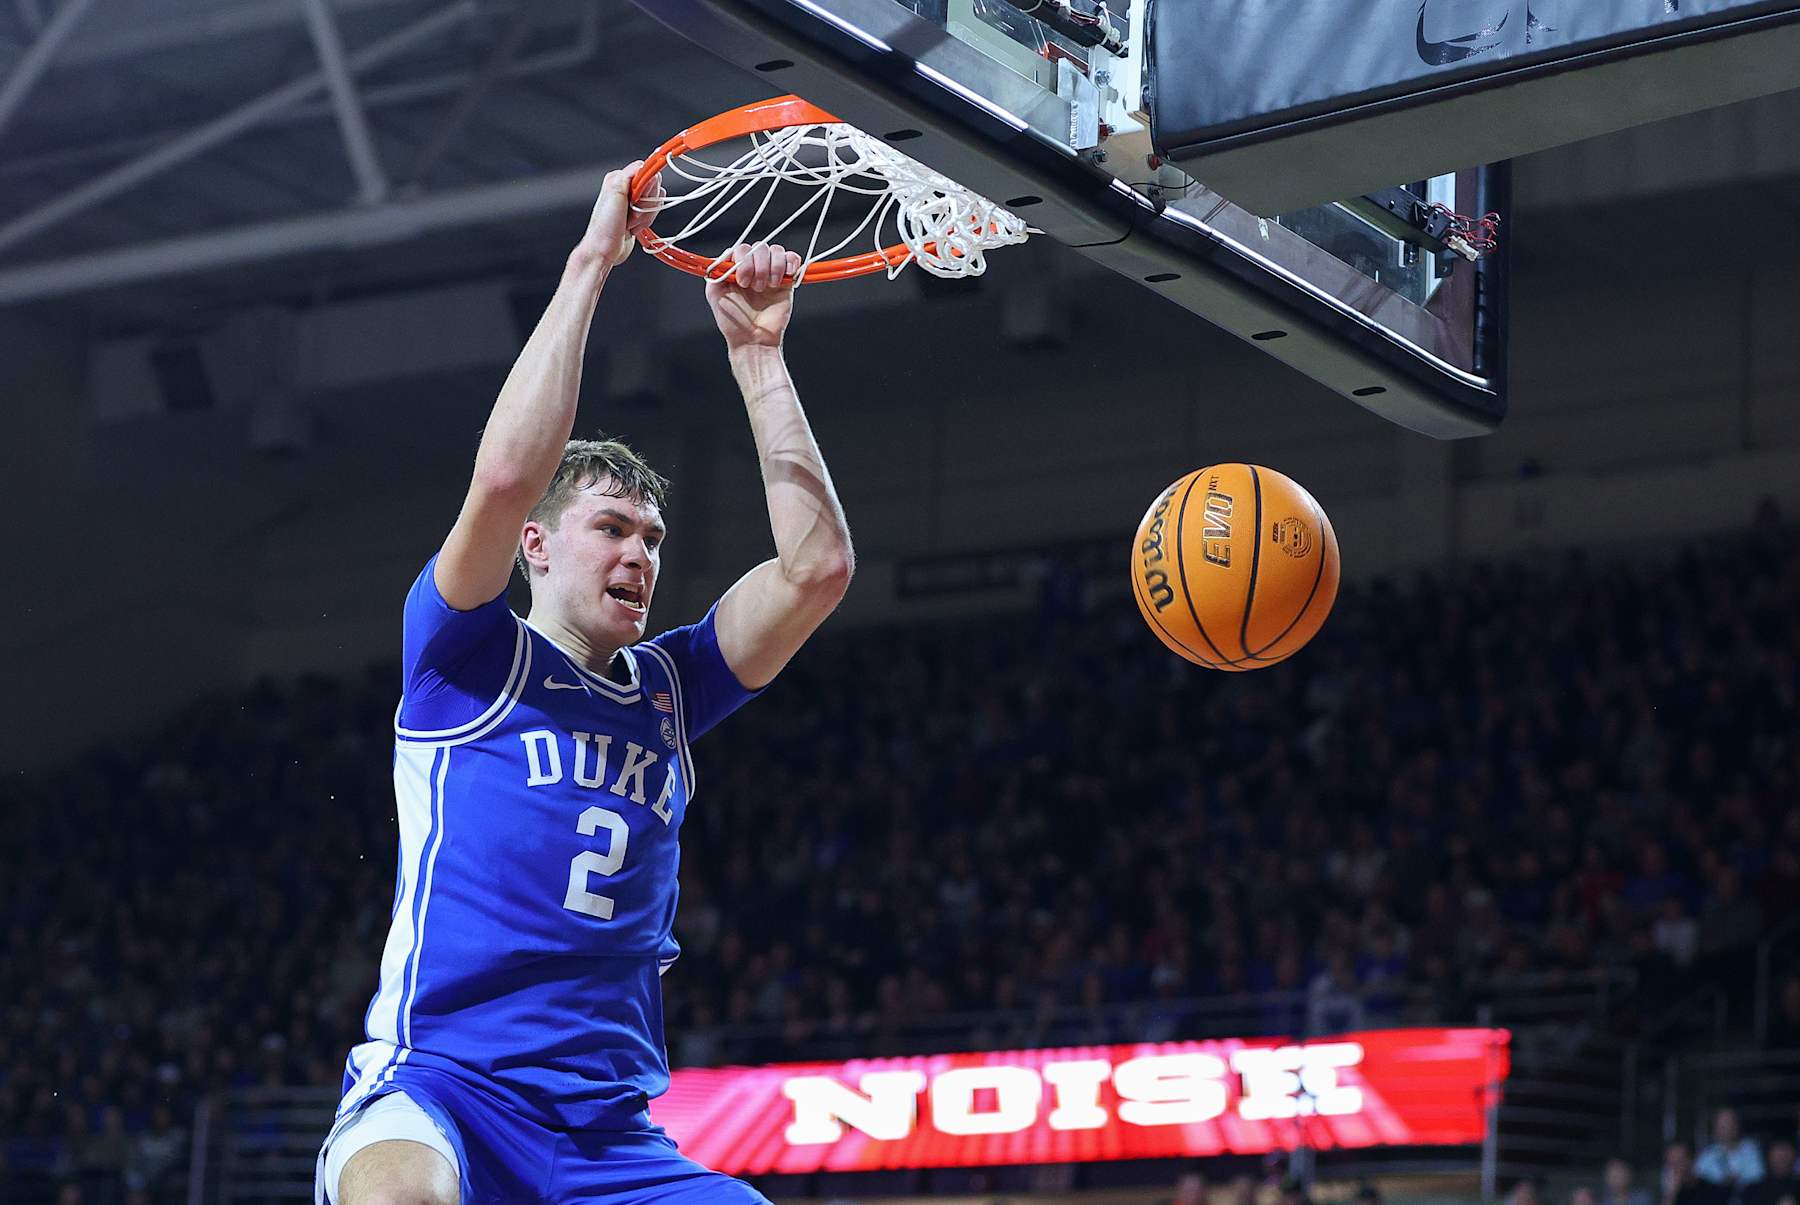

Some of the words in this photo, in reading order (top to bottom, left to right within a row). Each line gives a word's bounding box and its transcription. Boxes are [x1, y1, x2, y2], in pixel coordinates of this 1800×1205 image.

[1202, 492, 1233, 569] EVO
[1209, 475, 1220, 491] NXT
[519, 729, 677, 826] DUKE
[562, 805, 630, 921] 2
[783, 1042, 1364, 1146] NOISE
